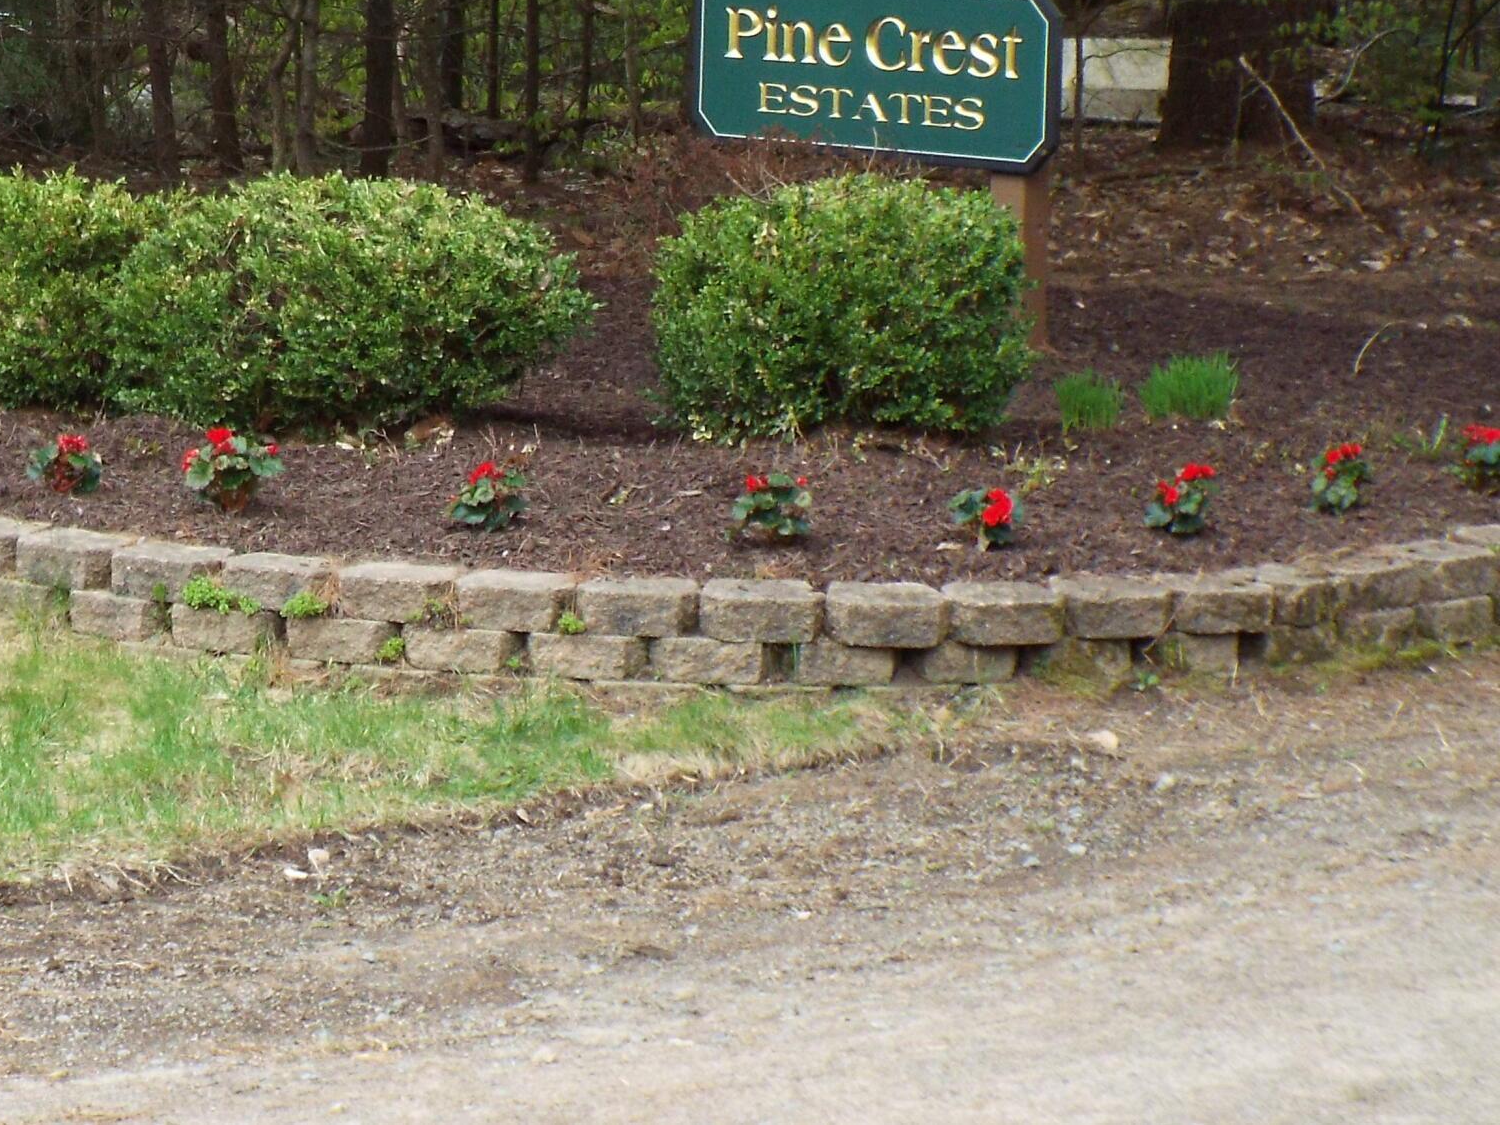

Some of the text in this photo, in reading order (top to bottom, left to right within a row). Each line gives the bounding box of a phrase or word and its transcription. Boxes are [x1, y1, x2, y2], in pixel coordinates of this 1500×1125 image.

[723, 5, 1023, 79] Pine Crest
[757, 82, 985, 130] ESTATES
